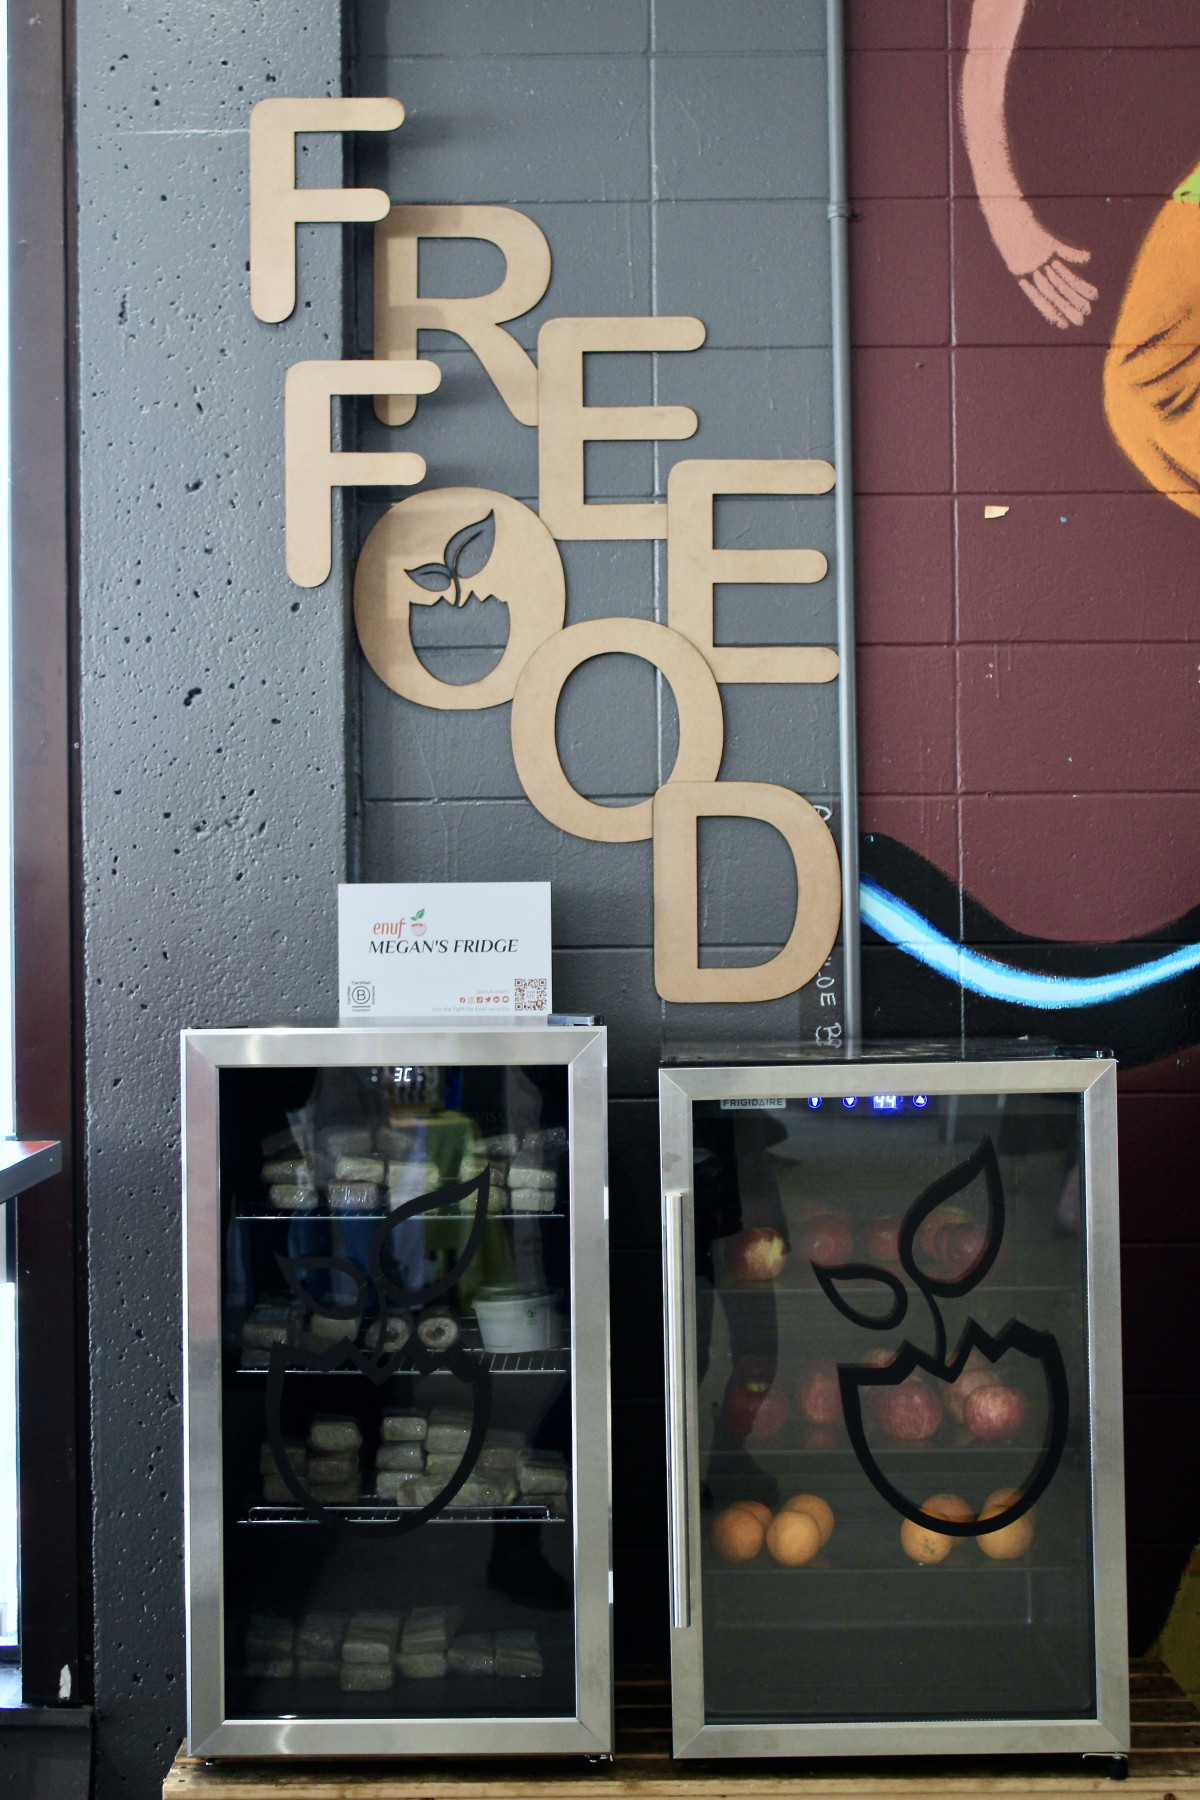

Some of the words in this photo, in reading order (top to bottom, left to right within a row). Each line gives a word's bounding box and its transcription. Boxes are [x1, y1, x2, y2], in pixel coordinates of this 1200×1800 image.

[249, 97, 839, 684] FREE
[285, 359, 842, 1003] FOOD
[373, 917, 407, 939] enuf
[369, 939, 449, 954] MEGAN'S
[453, 938, 519, 953] FRIDGE
[723, 1098, 783, 1107] FRIGIDAIRE
[874, 1095, 897, 1108] 44
